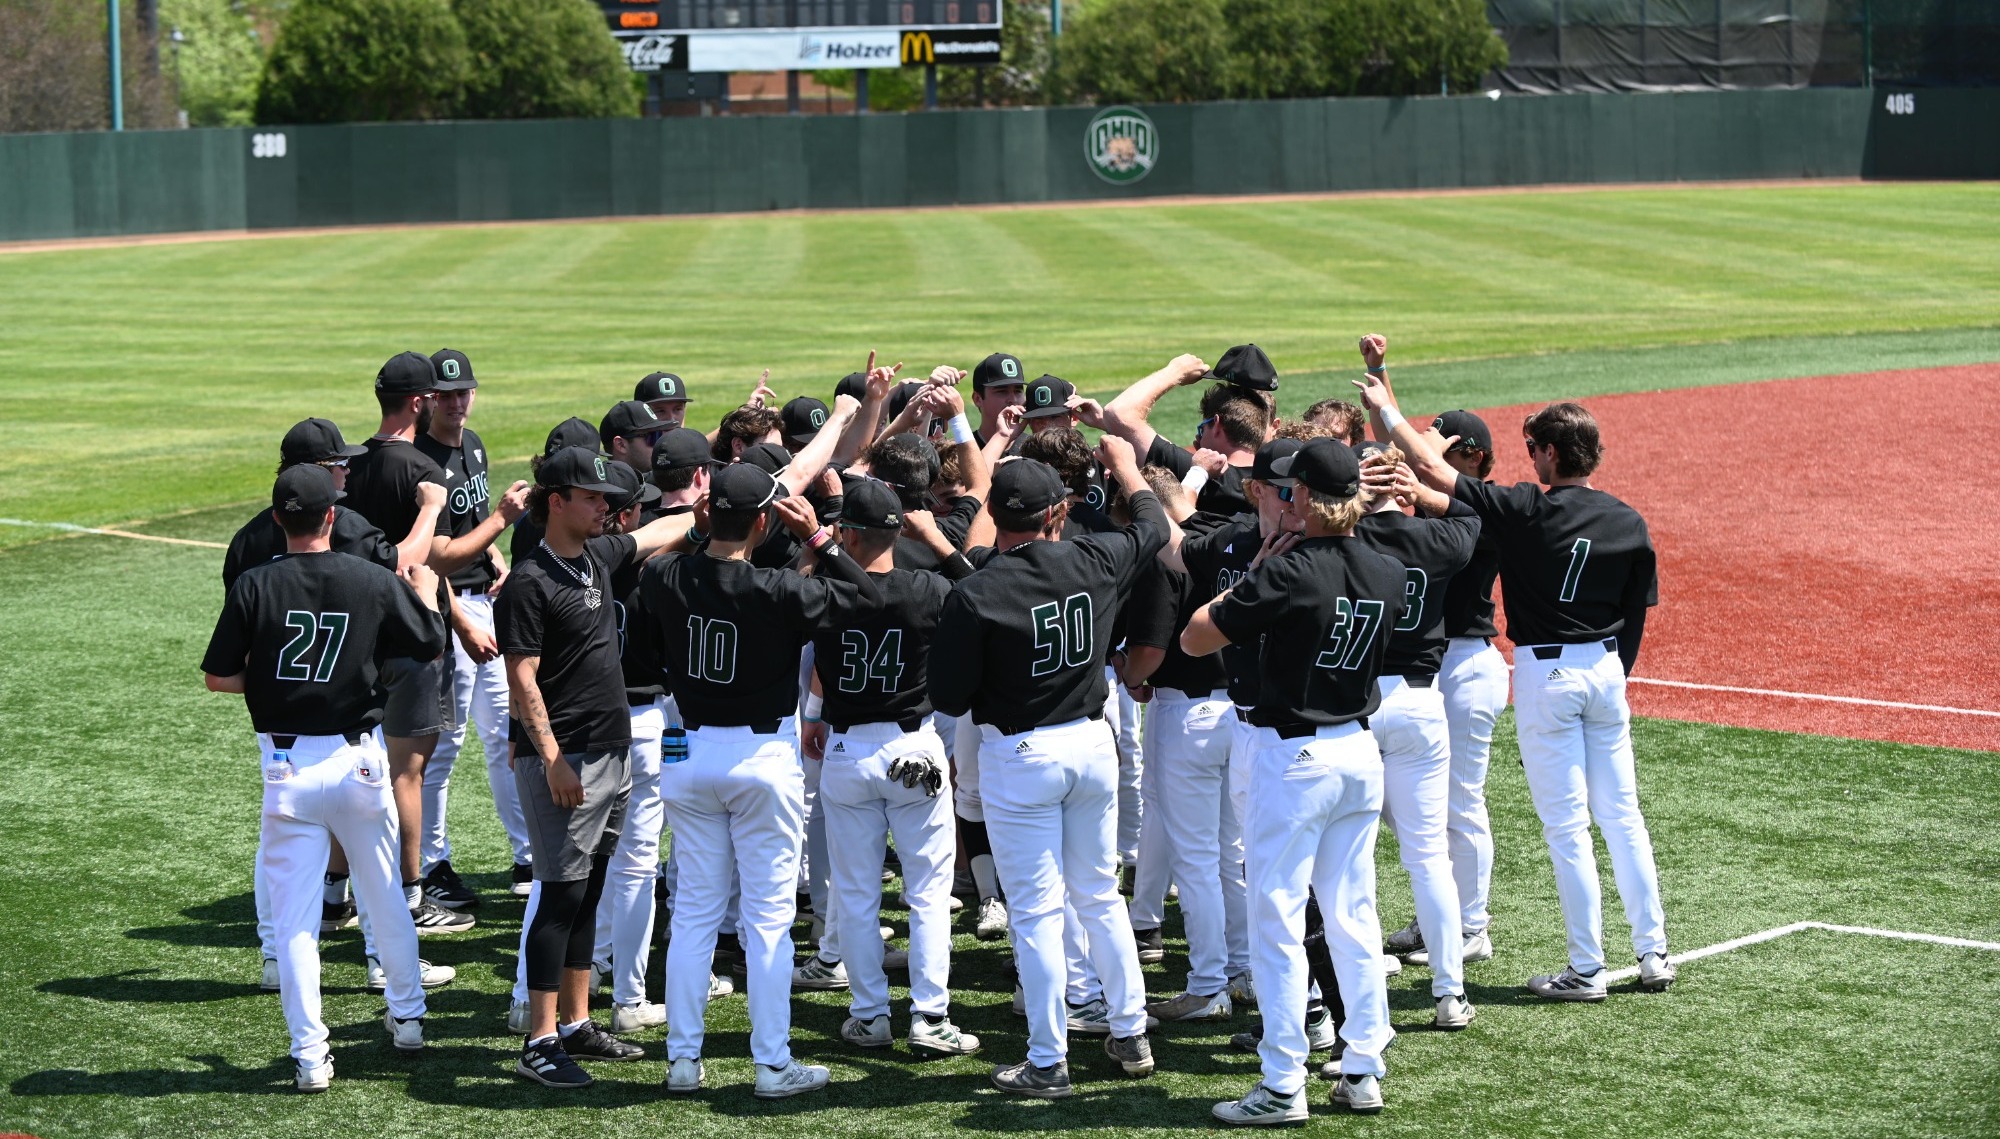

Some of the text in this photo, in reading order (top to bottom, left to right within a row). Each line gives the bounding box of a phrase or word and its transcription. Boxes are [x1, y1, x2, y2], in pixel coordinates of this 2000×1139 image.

[826, 43, 895, 59] Holzer
[1885, 93, 1915, 115] 405
[1559, 538, 1591, 602] 1
[276, 610, 350, 682] 27
[687, 614, 738, 684] 10
[838, 629, 904, 693] 34
[1032, 592, 1093, 677] 50
[1315, 596, 1385, 670] 37
